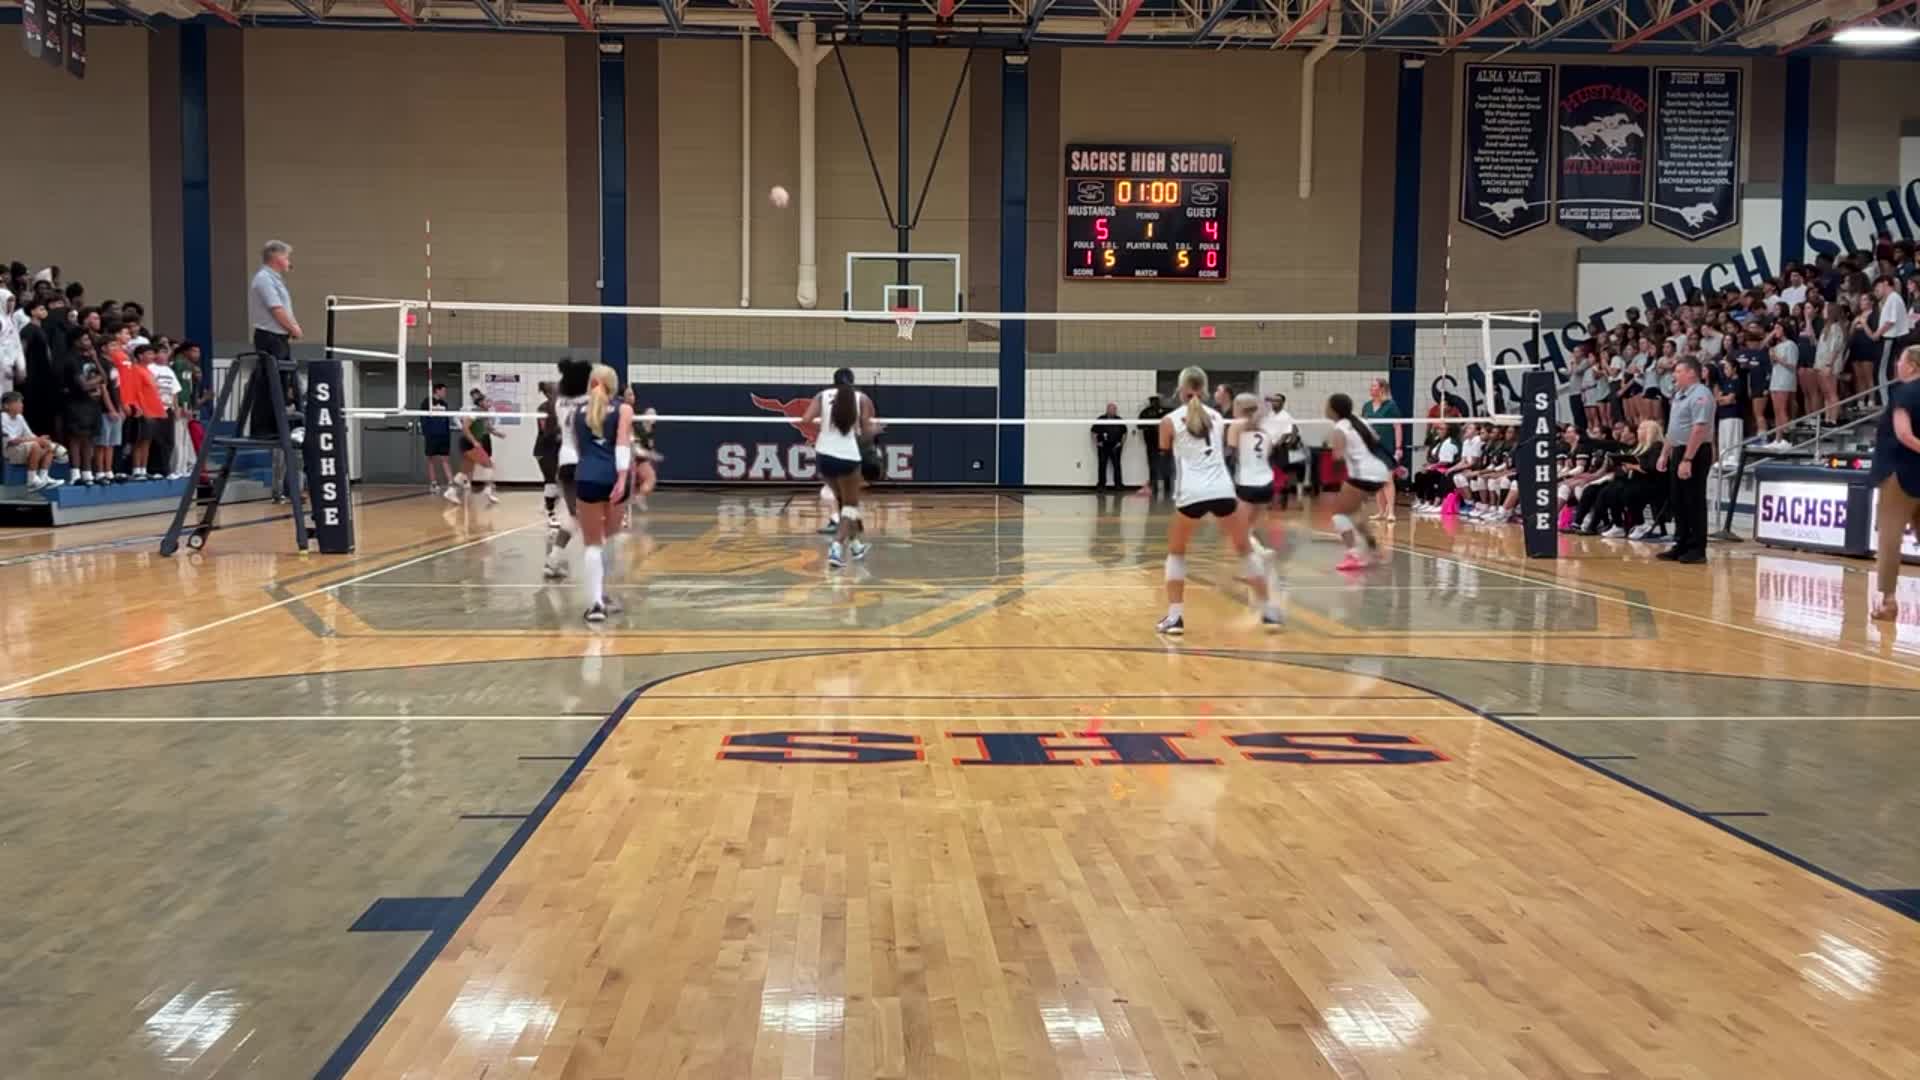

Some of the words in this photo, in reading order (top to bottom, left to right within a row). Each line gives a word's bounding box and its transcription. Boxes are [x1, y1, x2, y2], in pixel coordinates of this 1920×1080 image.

[1560, 84, 1648, 112] MUSTANG
[1071, 151, 1126, 172] SACHSE
[1131, 152, 1166, 172] HIGH
[1171, 153, 1225, 173] SCHOOL
[1118, 181, 1178, 203] 01:00
[1068, 206, 1116, 217] MUSTANGS
[1136, 212, 1160, 220] PERIOD
[1186, 207, 1217, 218] GUEST
[1095, 218, 1110, 240] 5
[1146, 222, 1153, 238] 1
[1205, 222, 1218, 240] 4
[1073, 241, 1095, 249] FOULS
[1126, 242, 1150, 250] PLAYER
[1152, 242, 1168, 250] FOUL
[1086, 250, 1092, 265] 1
[1104, 249, 1116, 267] 5
[1177, 251, 1189, 268] 5
[1206, 251, 1217, 268] 0
[1135, 269, 1158, 277] MATCH
[1253, 433, 1264, 452] 2
[316, 382, 339, 525] SACHSE
[717, 443, 914, 480] SACE
[1535, 392, 1550, 530] SACHSE
[1761, 494, 1848, 528] SACHSE
[716, 731, 1452, 765] SHS
